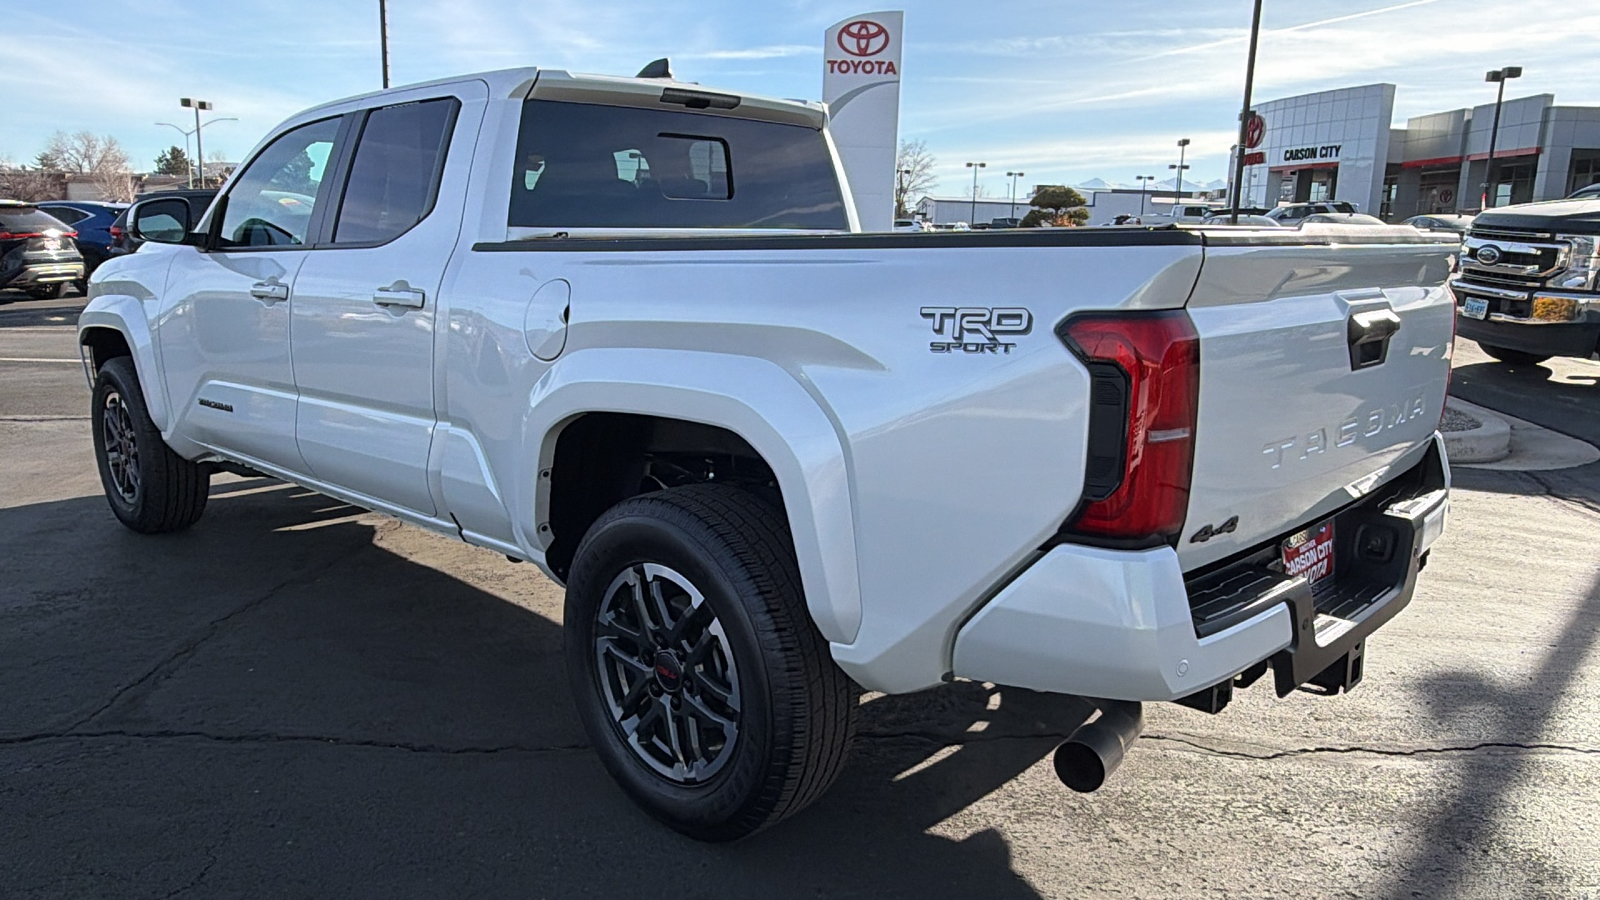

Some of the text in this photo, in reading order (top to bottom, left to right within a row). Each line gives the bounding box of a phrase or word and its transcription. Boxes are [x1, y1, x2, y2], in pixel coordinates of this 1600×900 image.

[827, 60, 897, 75] TOYOTA
[1284, 145, 1342, 161] CARSON CITY
[920, 306, 1034, 343] TRD
[929, 342, 1017, 355] SPORT
[1262, 393, 1427, 469] TACOMA
[1317, 538, 1333, 560] CITY
